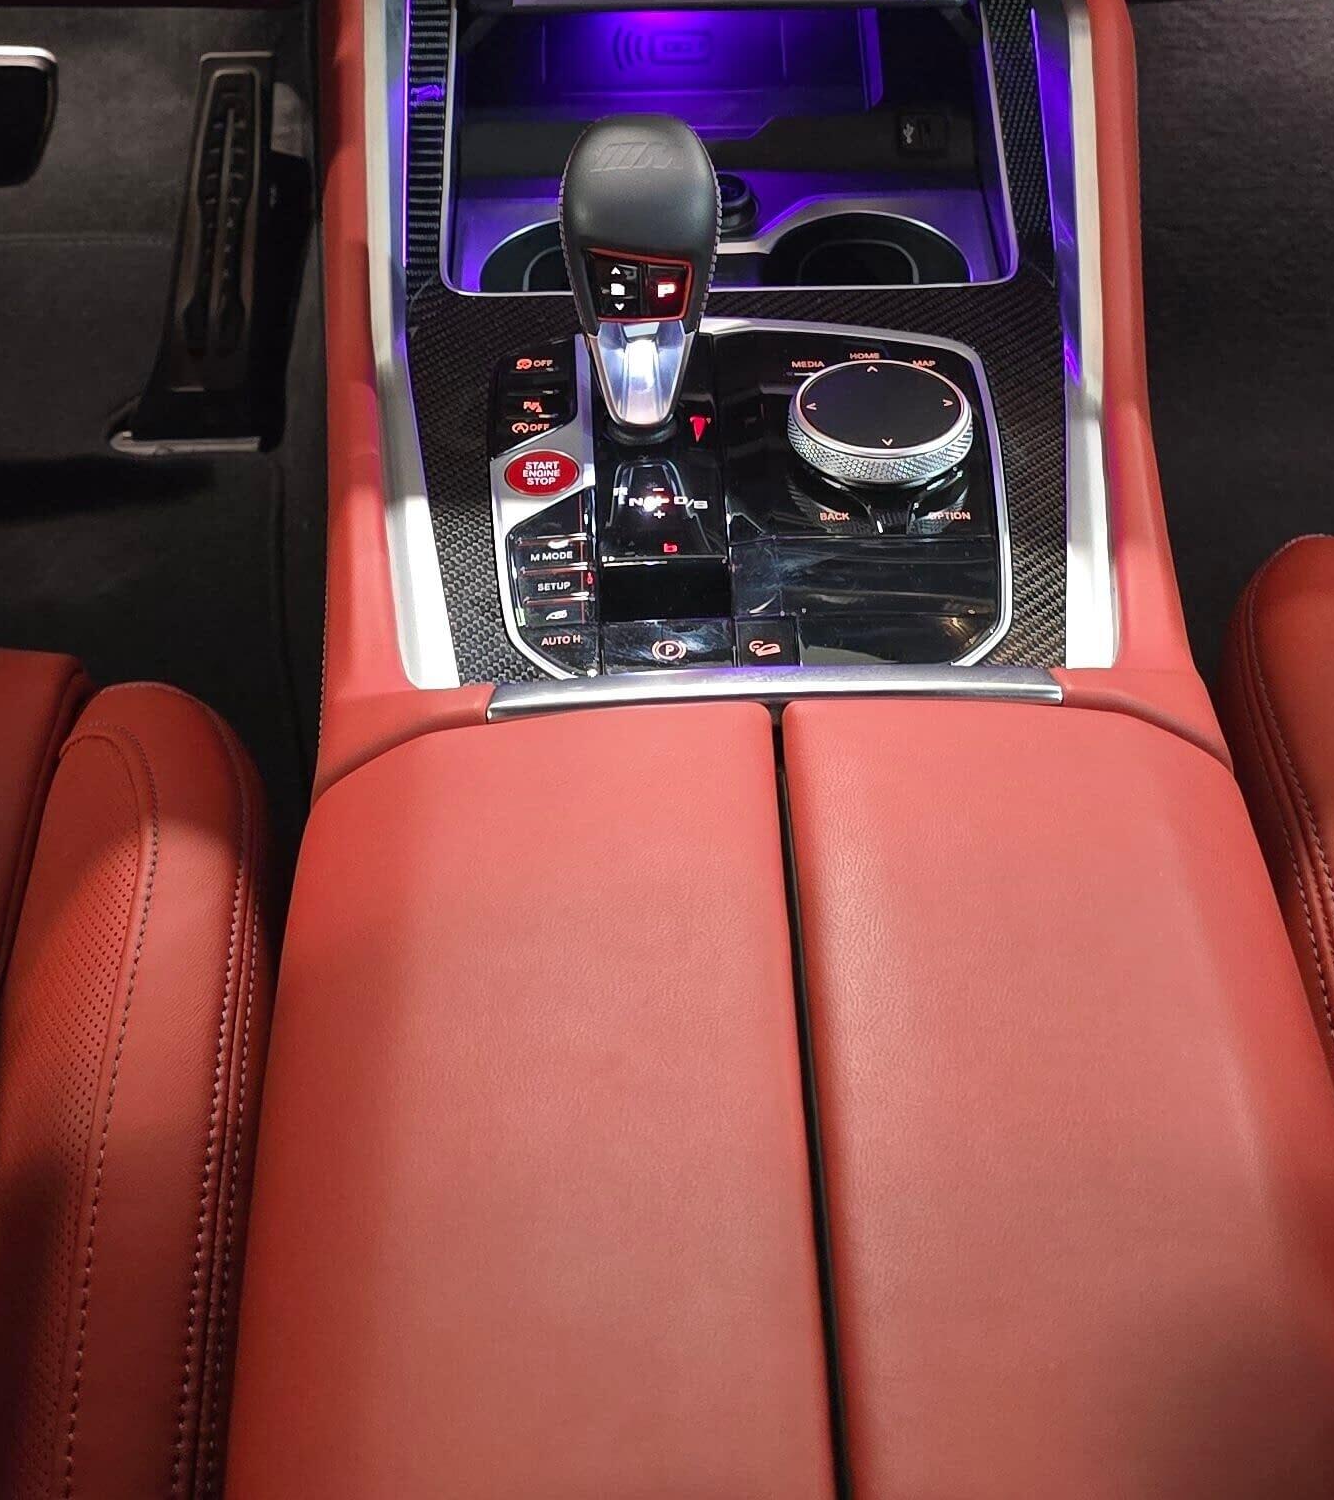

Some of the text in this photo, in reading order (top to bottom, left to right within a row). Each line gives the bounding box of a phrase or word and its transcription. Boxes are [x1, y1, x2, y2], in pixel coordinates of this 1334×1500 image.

[533, 359, 553, 367] OFF
[791, 360, 825, 369] MEDIA
[912, 359, 937, 368] MAP
[529, 423, 550, 432] OFF
[525, 461, 560, 470] START
[522, 469, 560, 478] ENGINE
[526, 477, 556, 486] STOP
[819, 511, 850, 521] BACK
[928, 511, 971, 521] OPTION
[530, 551, 573, 561] M MODE
[537, 581, 571, 592] SETUP
[541, 636, 571, 646] AUTO
